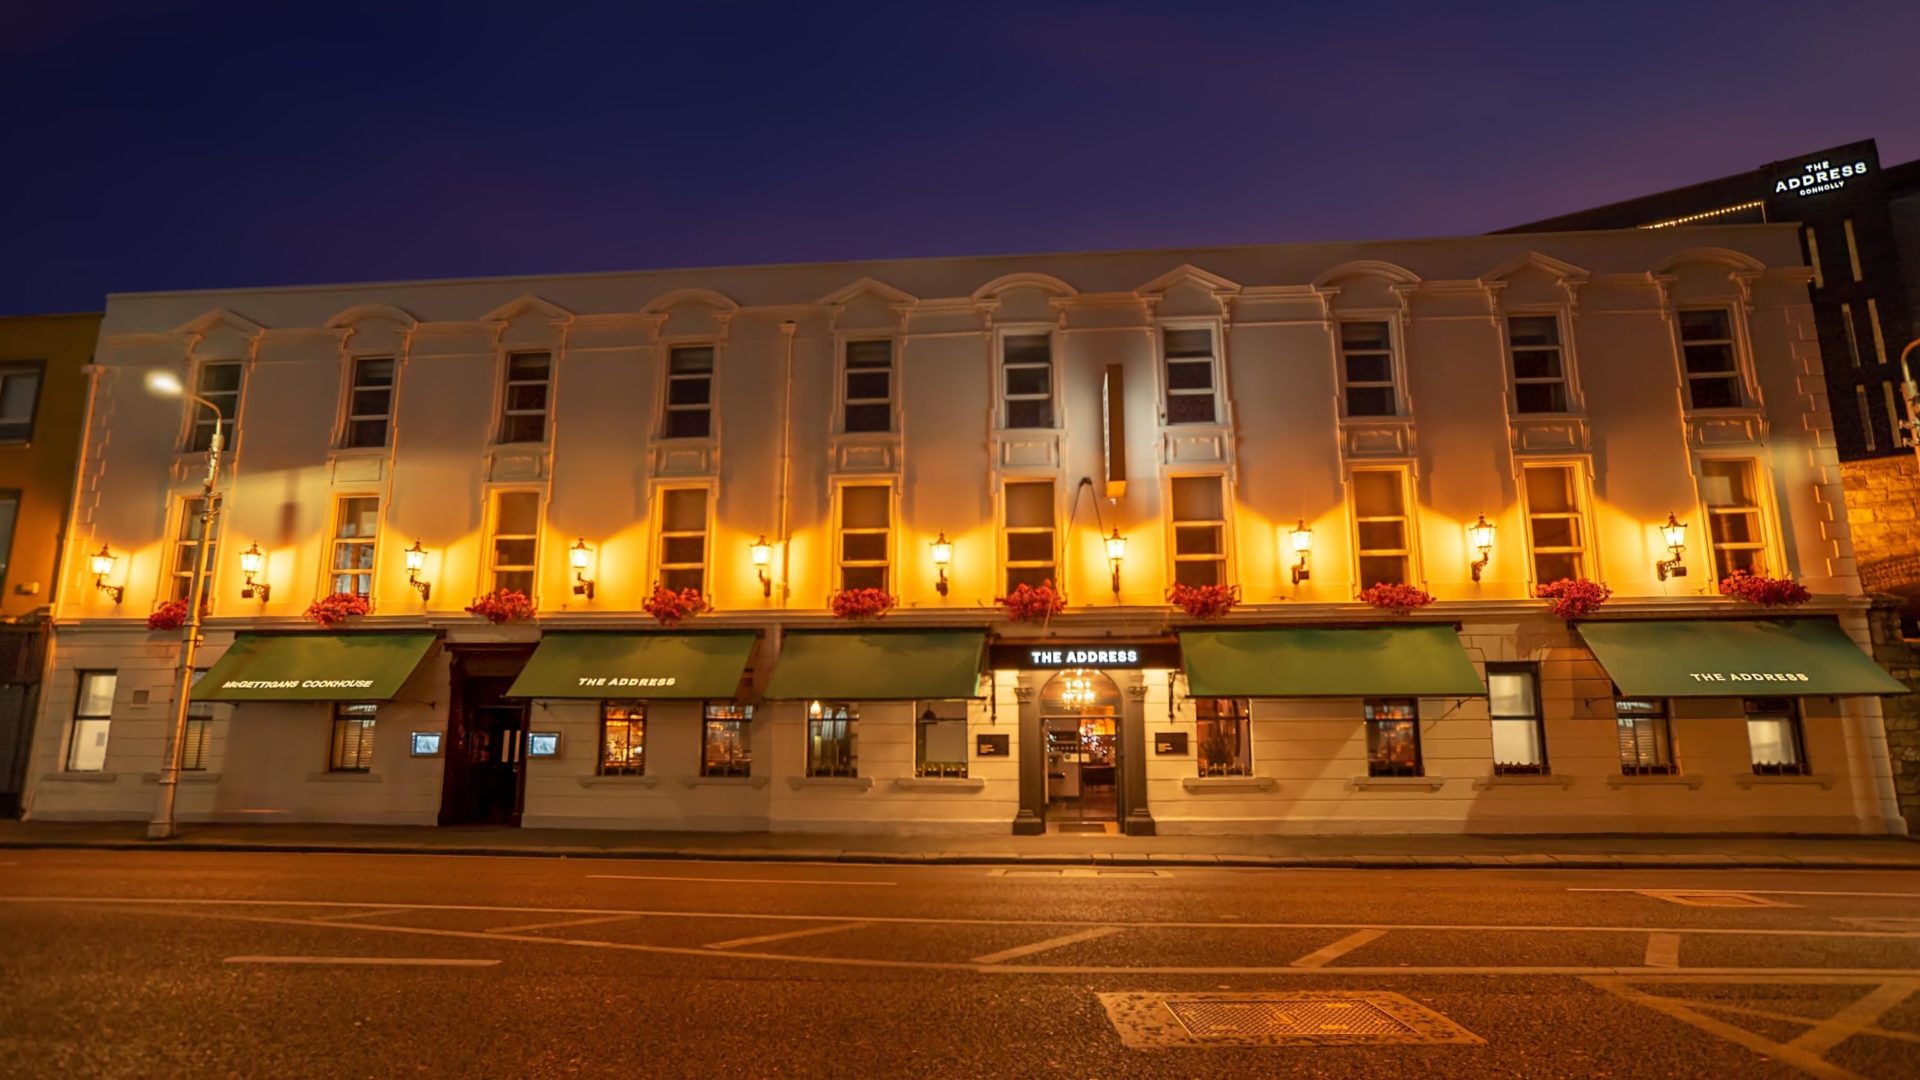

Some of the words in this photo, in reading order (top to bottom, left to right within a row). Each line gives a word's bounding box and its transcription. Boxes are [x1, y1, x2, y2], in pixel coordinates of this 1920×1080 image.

[1806, 161, 1829, 172] THE
[1775, 162, 1867, 193] ADDRESS
[1799, 180, 1845, 196] CONNOLLY
[1031, 651, 1062, 664] THE
[1066, 650, 1138, 664] ADDRESS
[578, 678, 607, 687] THE
[608, 678, 676, 687] ADDRESS
[1690, 673, 1726, 682] THE
[1730, 673, 1809, 682] ADDRESS
[301, 680, 374, 688] COOKHOUSE
